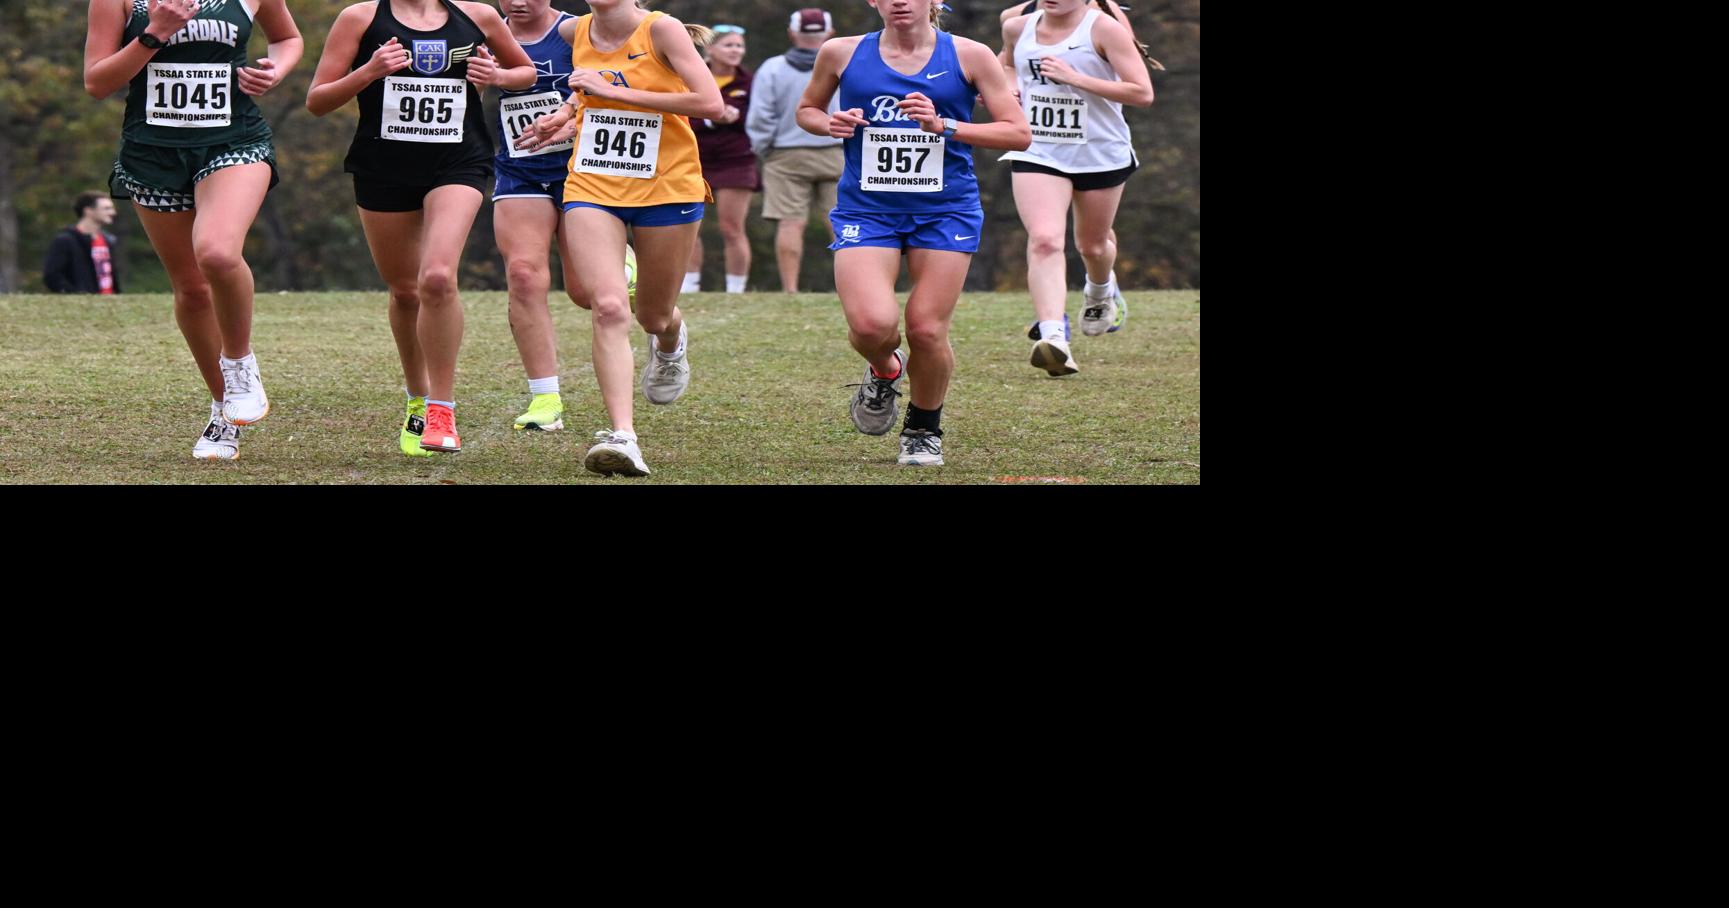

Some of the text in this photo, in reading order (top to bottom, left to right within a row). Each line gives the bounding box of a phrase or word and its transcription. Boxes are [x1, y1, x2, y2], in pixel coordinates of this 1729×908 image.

[167, 19, 239, 48] VERDALE
[418, 44, 441, 52] CAK
[154, 69, 227, 79] TSSAA STATE XC
[392, 83, 463, 94] TSSAA STATE XC
[154, 82, 227, 110] 1045
[1031, 94, 1050, 104] TSSAA
[1051, 97, 1072, 105] STATE
[399, 96, 454, 124] 965
[504, 97, 560, 112] TSSAA STATE XC
[152, 111, 227, 121] CHAMPIONSHIPS
[590, 114, 658, 129] TSSAA STATE XC
[1030, 105, 1082, 129] 1011
[387, 125, 459, 136] CHAMPIONSHIPS
[507, 109, 558, 140] 10
[869, 133, 941, 143] TSSAA STATE XC
[1031, 129, 1084, 139] HAMPIONSHIPS
[593, 128, 648, 159] 946
[581, 158, 652, 172] CHAMPIONSHIPS
[877, 146, 931, 173] 957
[867, 176, 939, 186] CHAMPIONSHIPS
